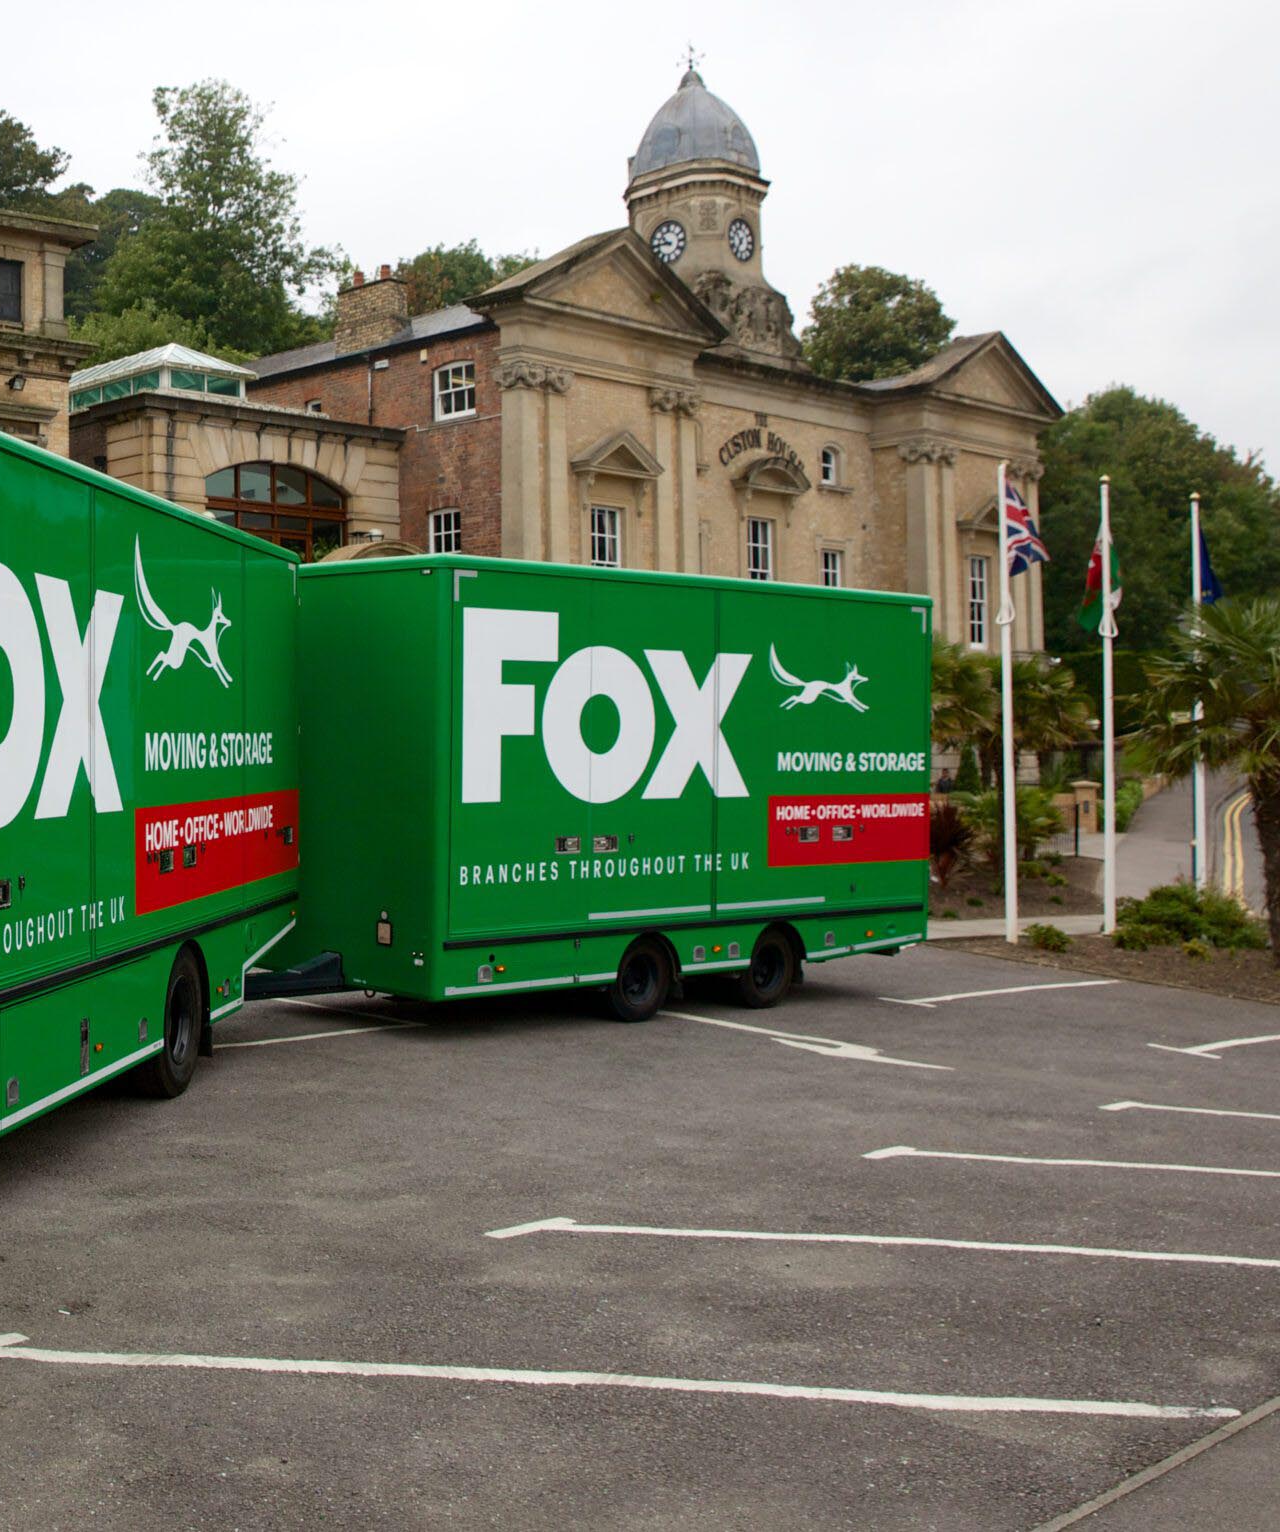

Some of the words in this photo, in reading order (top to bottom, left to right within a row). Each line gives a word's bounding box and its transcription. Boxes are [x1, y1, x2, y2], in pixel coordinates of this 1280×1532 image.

[461, 607, 754, 804] FOX
[144, 732, 207, 771] MOVING
[209, 733, 219, 769] &
[220, 732, 273, 767] STORAGE
[777, 751, 843, 772] MOVING
[845, 752, 857, 772] &
[858, 752, 926, 772] STORAGE
[459, 861, 559, 886] BRANCHES
[569, 855, 686, 880] THROUGHOUT
[694, 853, 723, 872] THE
[730, 852, 750, 870] UK
[81, 900, 104, 932] THE
[110, 895, 125, 924] UK
